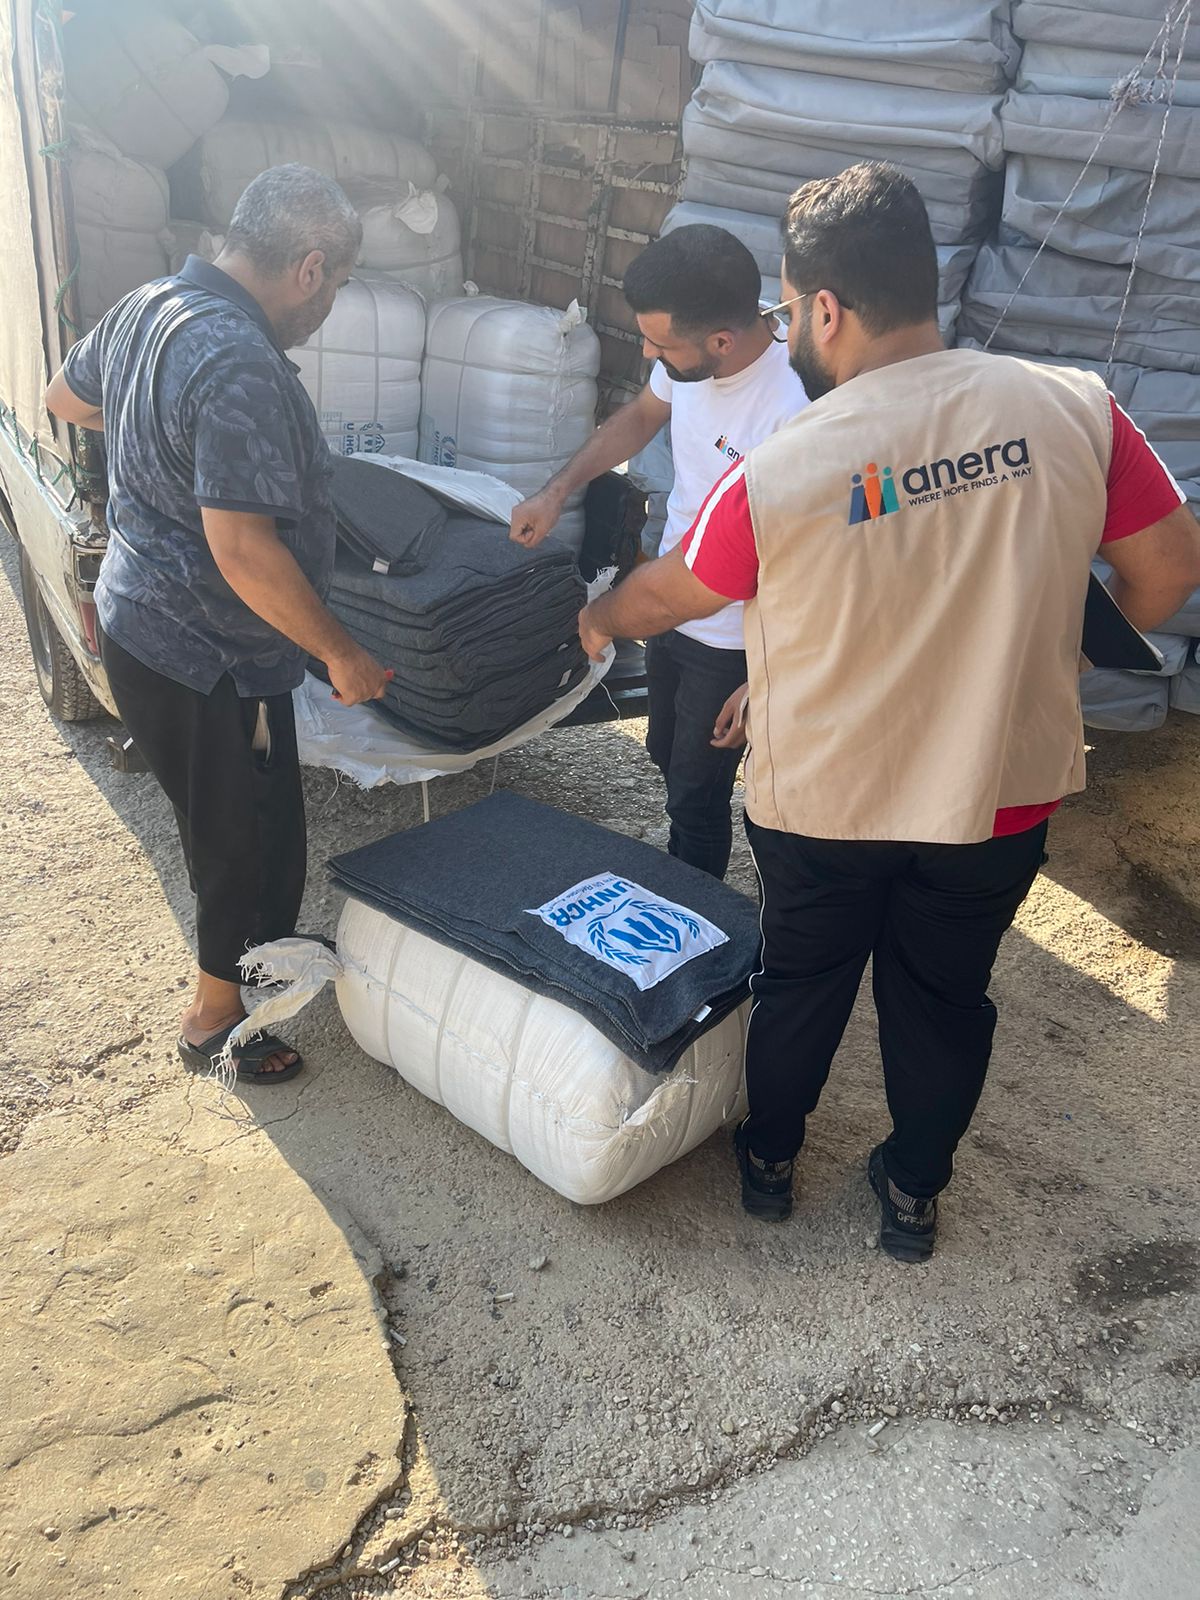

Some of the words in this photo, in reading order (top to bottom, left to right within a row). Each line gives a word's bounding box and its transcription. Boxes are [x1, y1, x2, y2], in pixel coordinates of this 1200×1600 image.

[902, 438, 1030, 495] anera
[908, 491, 942, 506] WHERE
[943, 483, 969, 497] HOPE
[971, 475, 998, 490] FINDS
[1001, 474, 1009, 482] A
[1011, 466, 1032, 479] WAY
[548, 881, 636, 927] UNHCR
